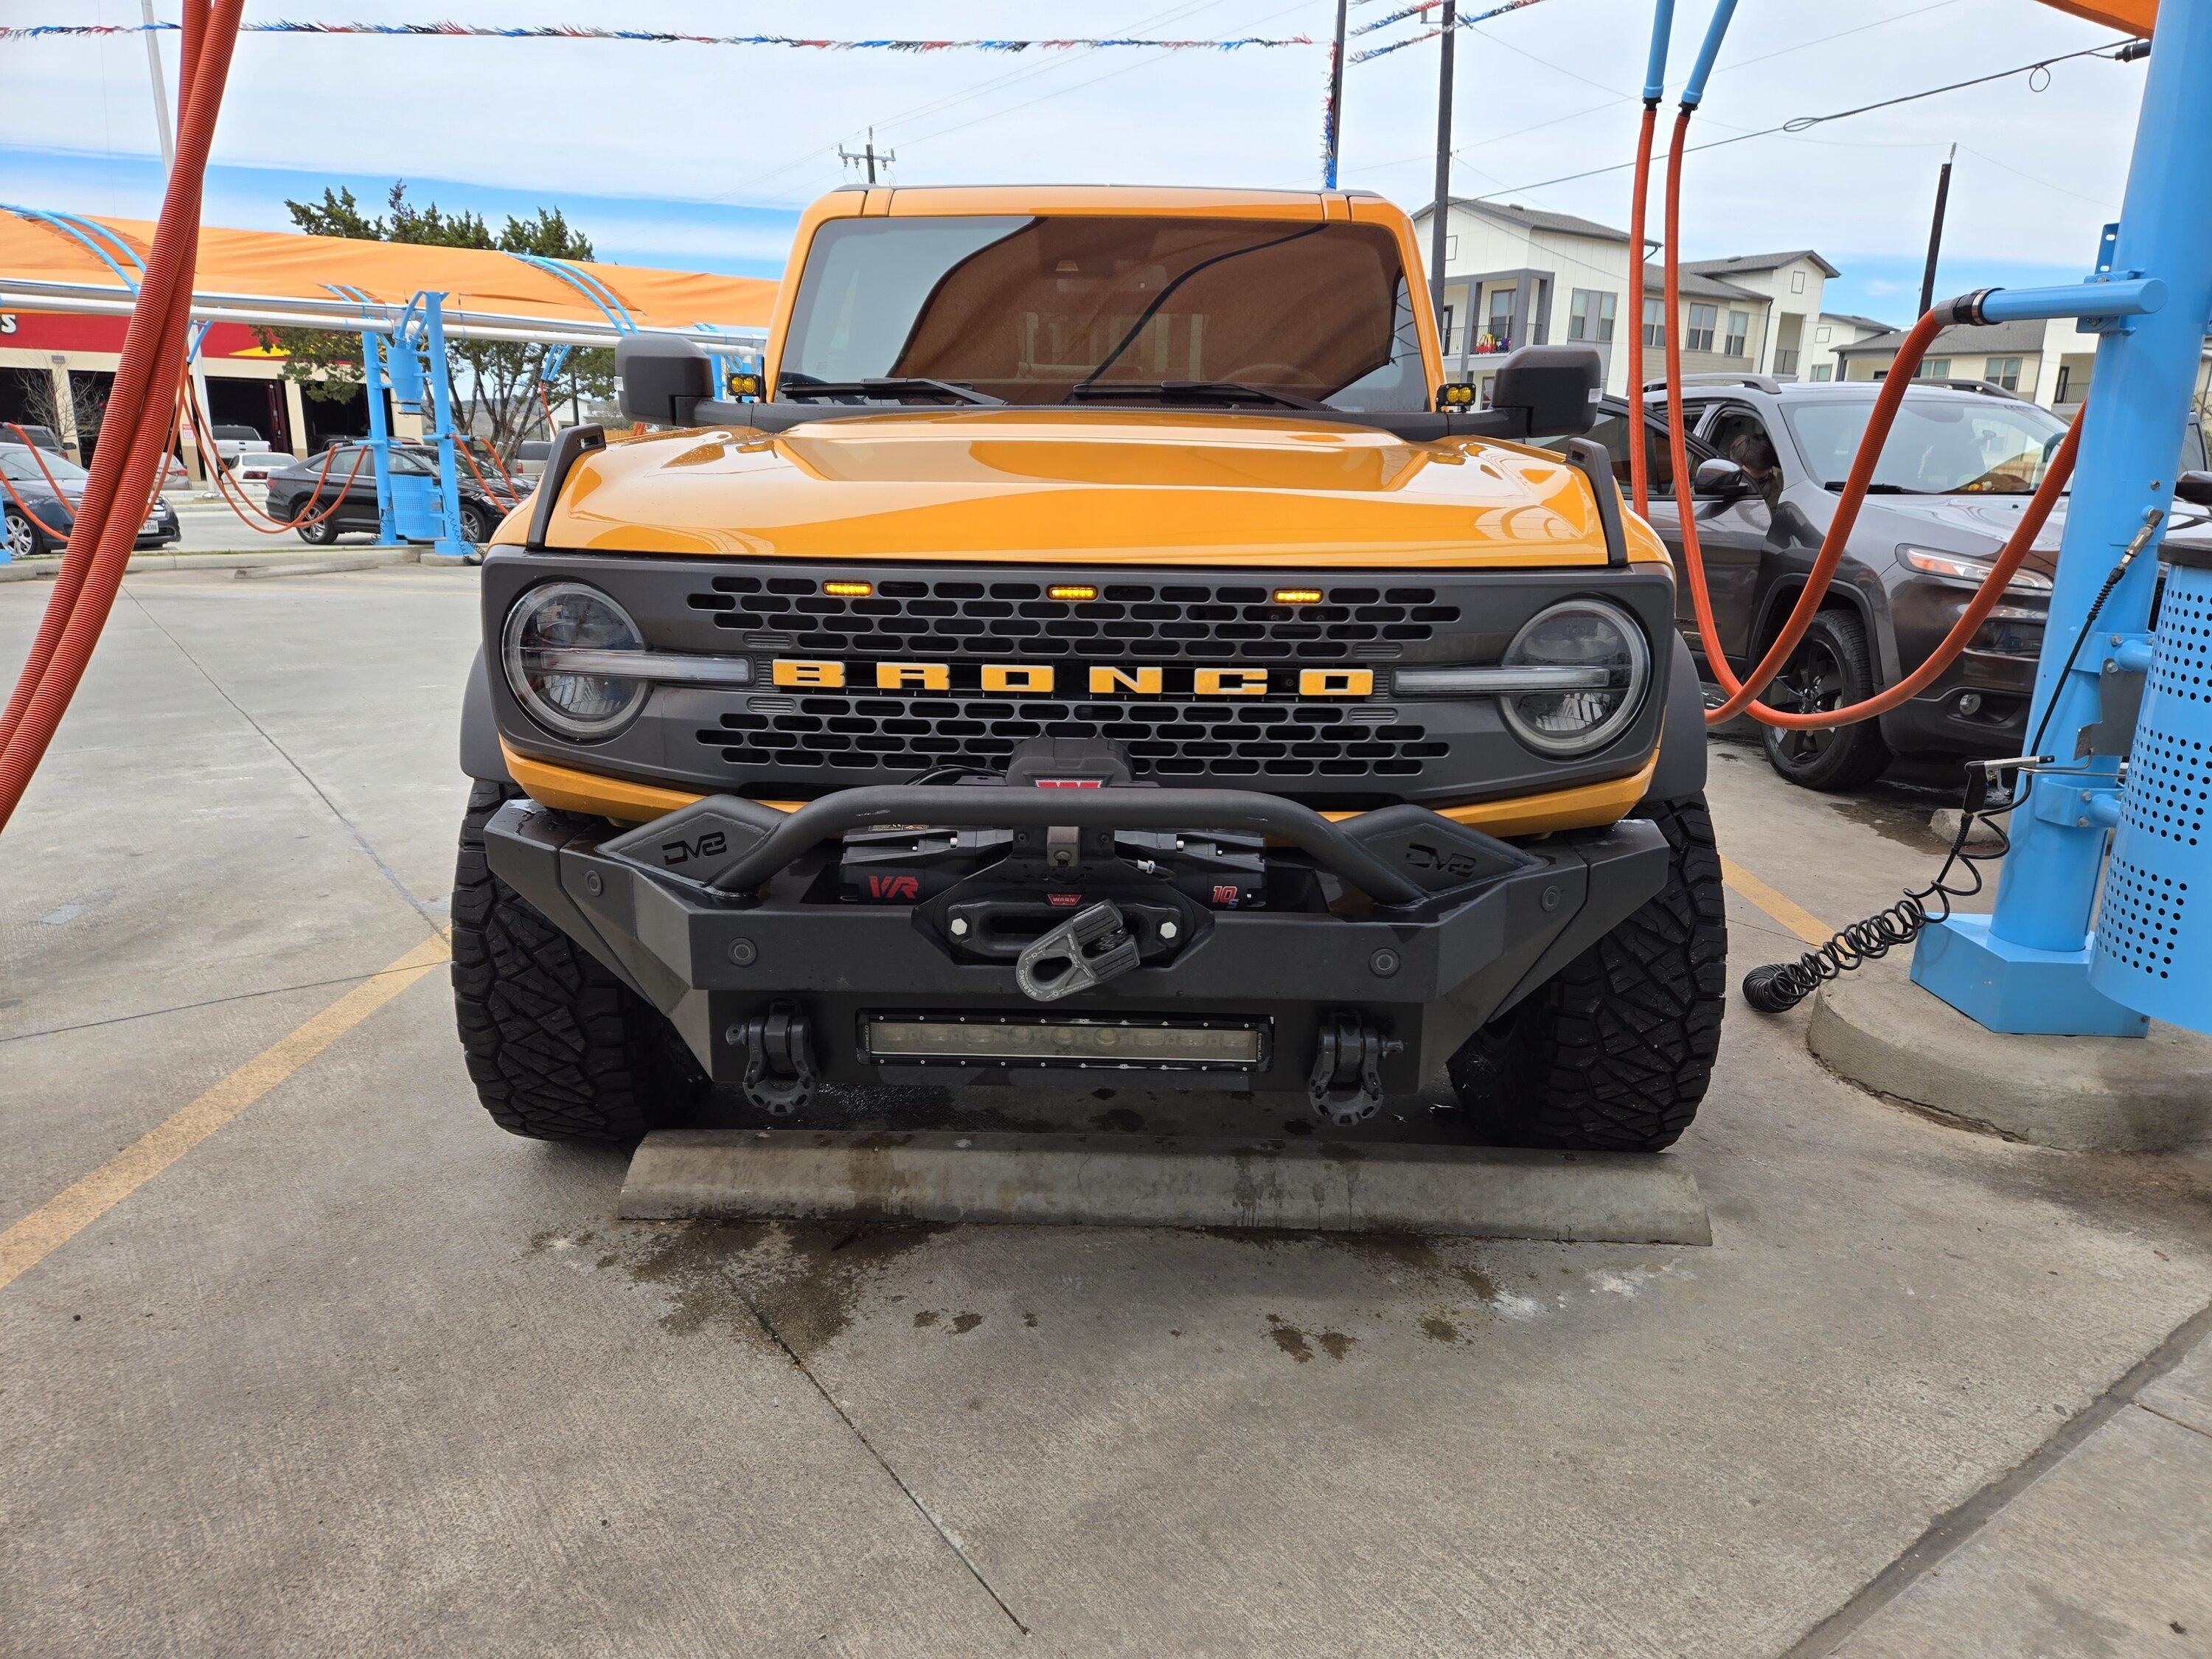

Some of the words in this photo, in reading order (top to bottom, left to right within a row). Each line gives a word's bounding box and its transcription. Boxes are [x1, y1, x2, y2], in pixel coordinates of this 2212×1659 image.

[772, 658, 1374, 696] BRONCO
[869, 875, 919, 899] VR
[1018, 969, 1037, 998] WARNING
